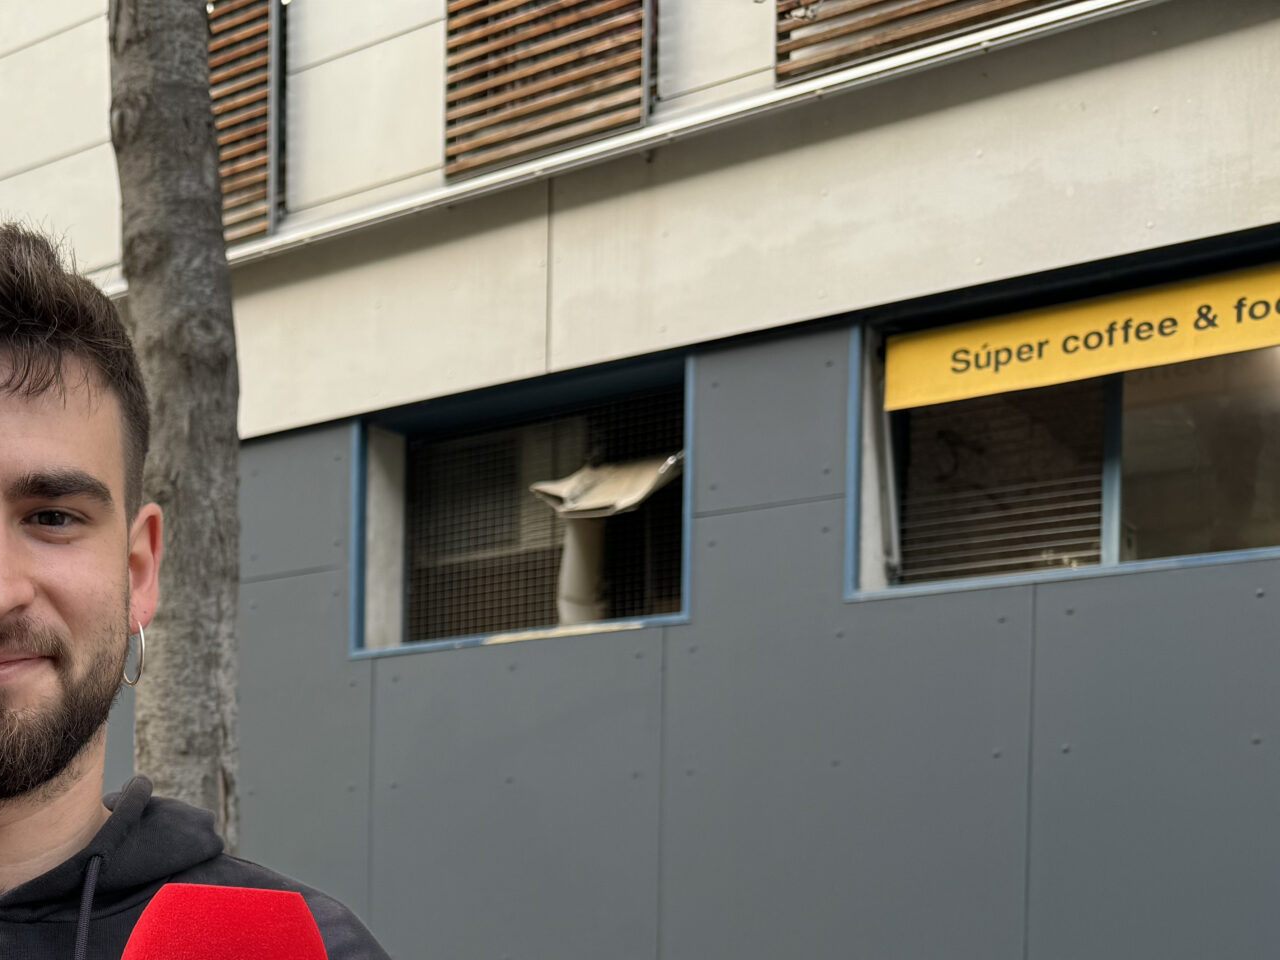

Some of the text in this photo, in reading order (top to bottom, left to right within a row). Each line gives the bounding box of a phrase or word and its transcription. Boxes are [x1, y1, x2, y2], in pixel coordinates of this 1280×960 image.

[950, 297, 1280, 374] Súper coffee & fo
